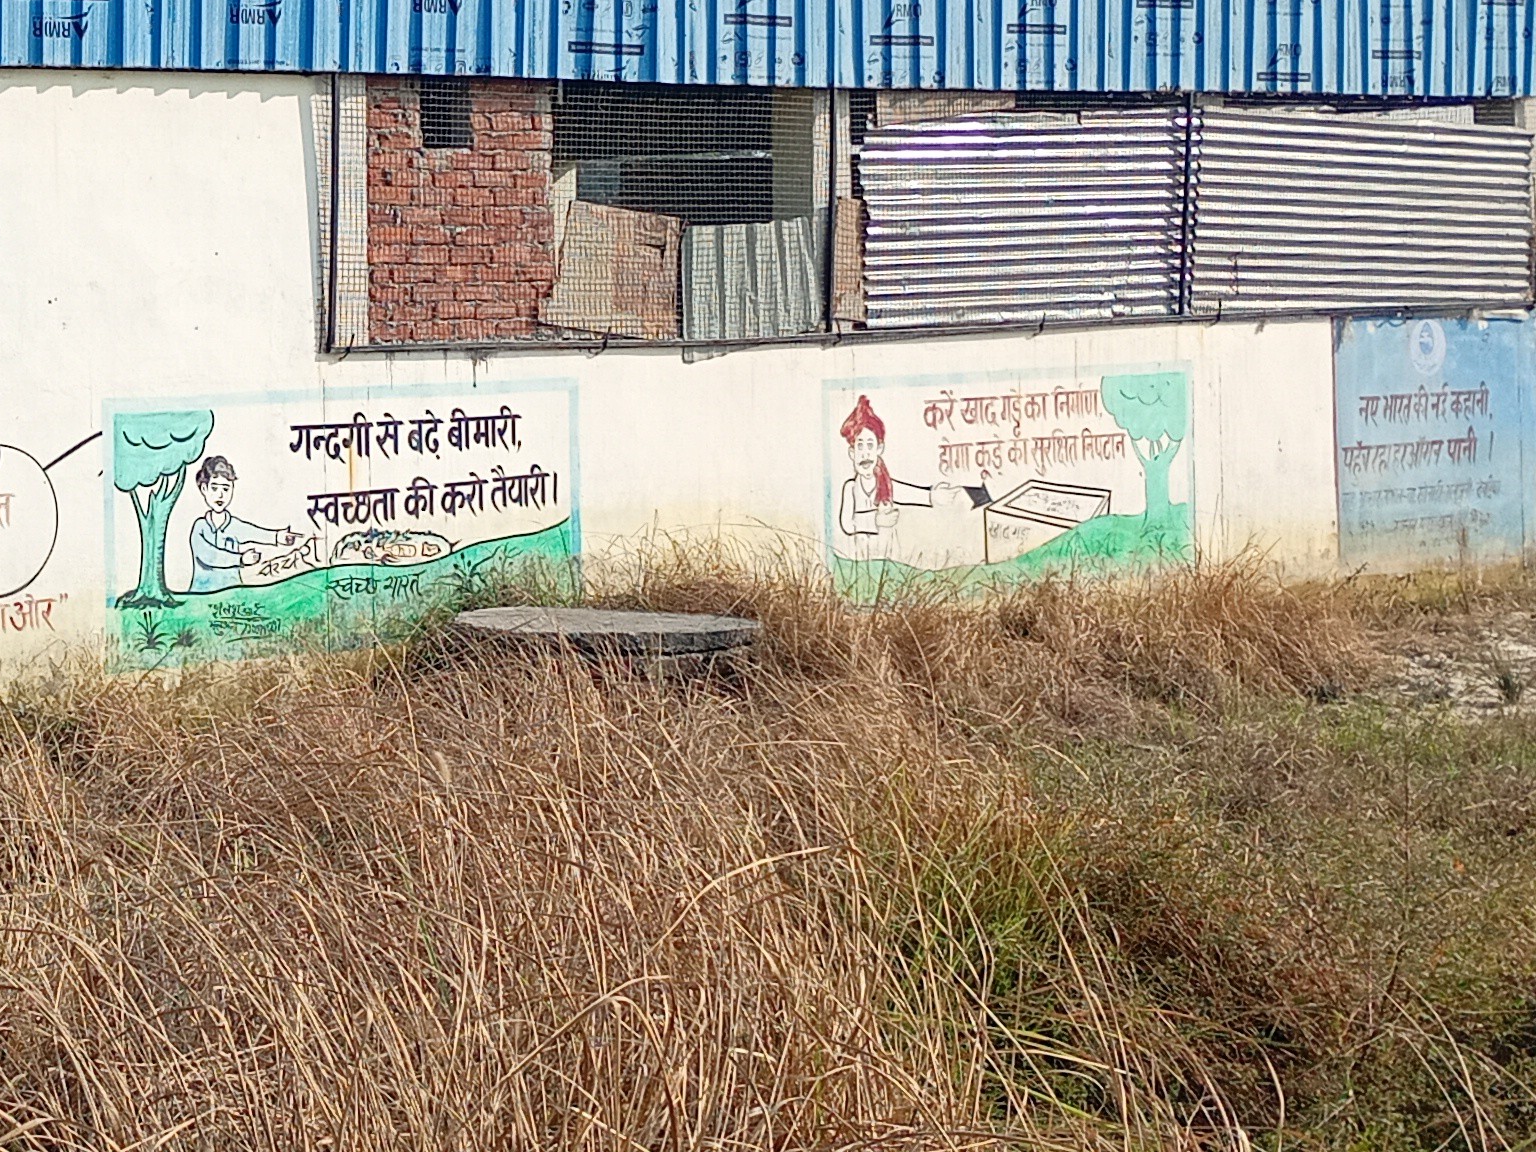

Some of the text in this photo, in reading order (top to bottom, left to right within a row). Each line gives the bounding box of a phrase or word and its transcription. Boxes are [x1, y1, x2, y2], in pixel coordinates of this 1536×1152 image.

[960, 395, 1000, 427] खाद
[1024, 392, 1050, 422] का
[1359, 395, 1381, 426] नए
[1382, 393, 1412, 425] भारत
[1430, 381, 1449, 423] नई
[290, 404, 523, 464] गन्दगी से बढ़े बीमारी,
[938, 435, 974, 478] होगा
[1031, 427, 1079, 477] सुरक्षित
[1446, 424, 1478, 465] पानी
[306, 487, 401, 530] स्वच्छता
[404, 475, 438, 519] की
[441, 471, 489, 517] करो
